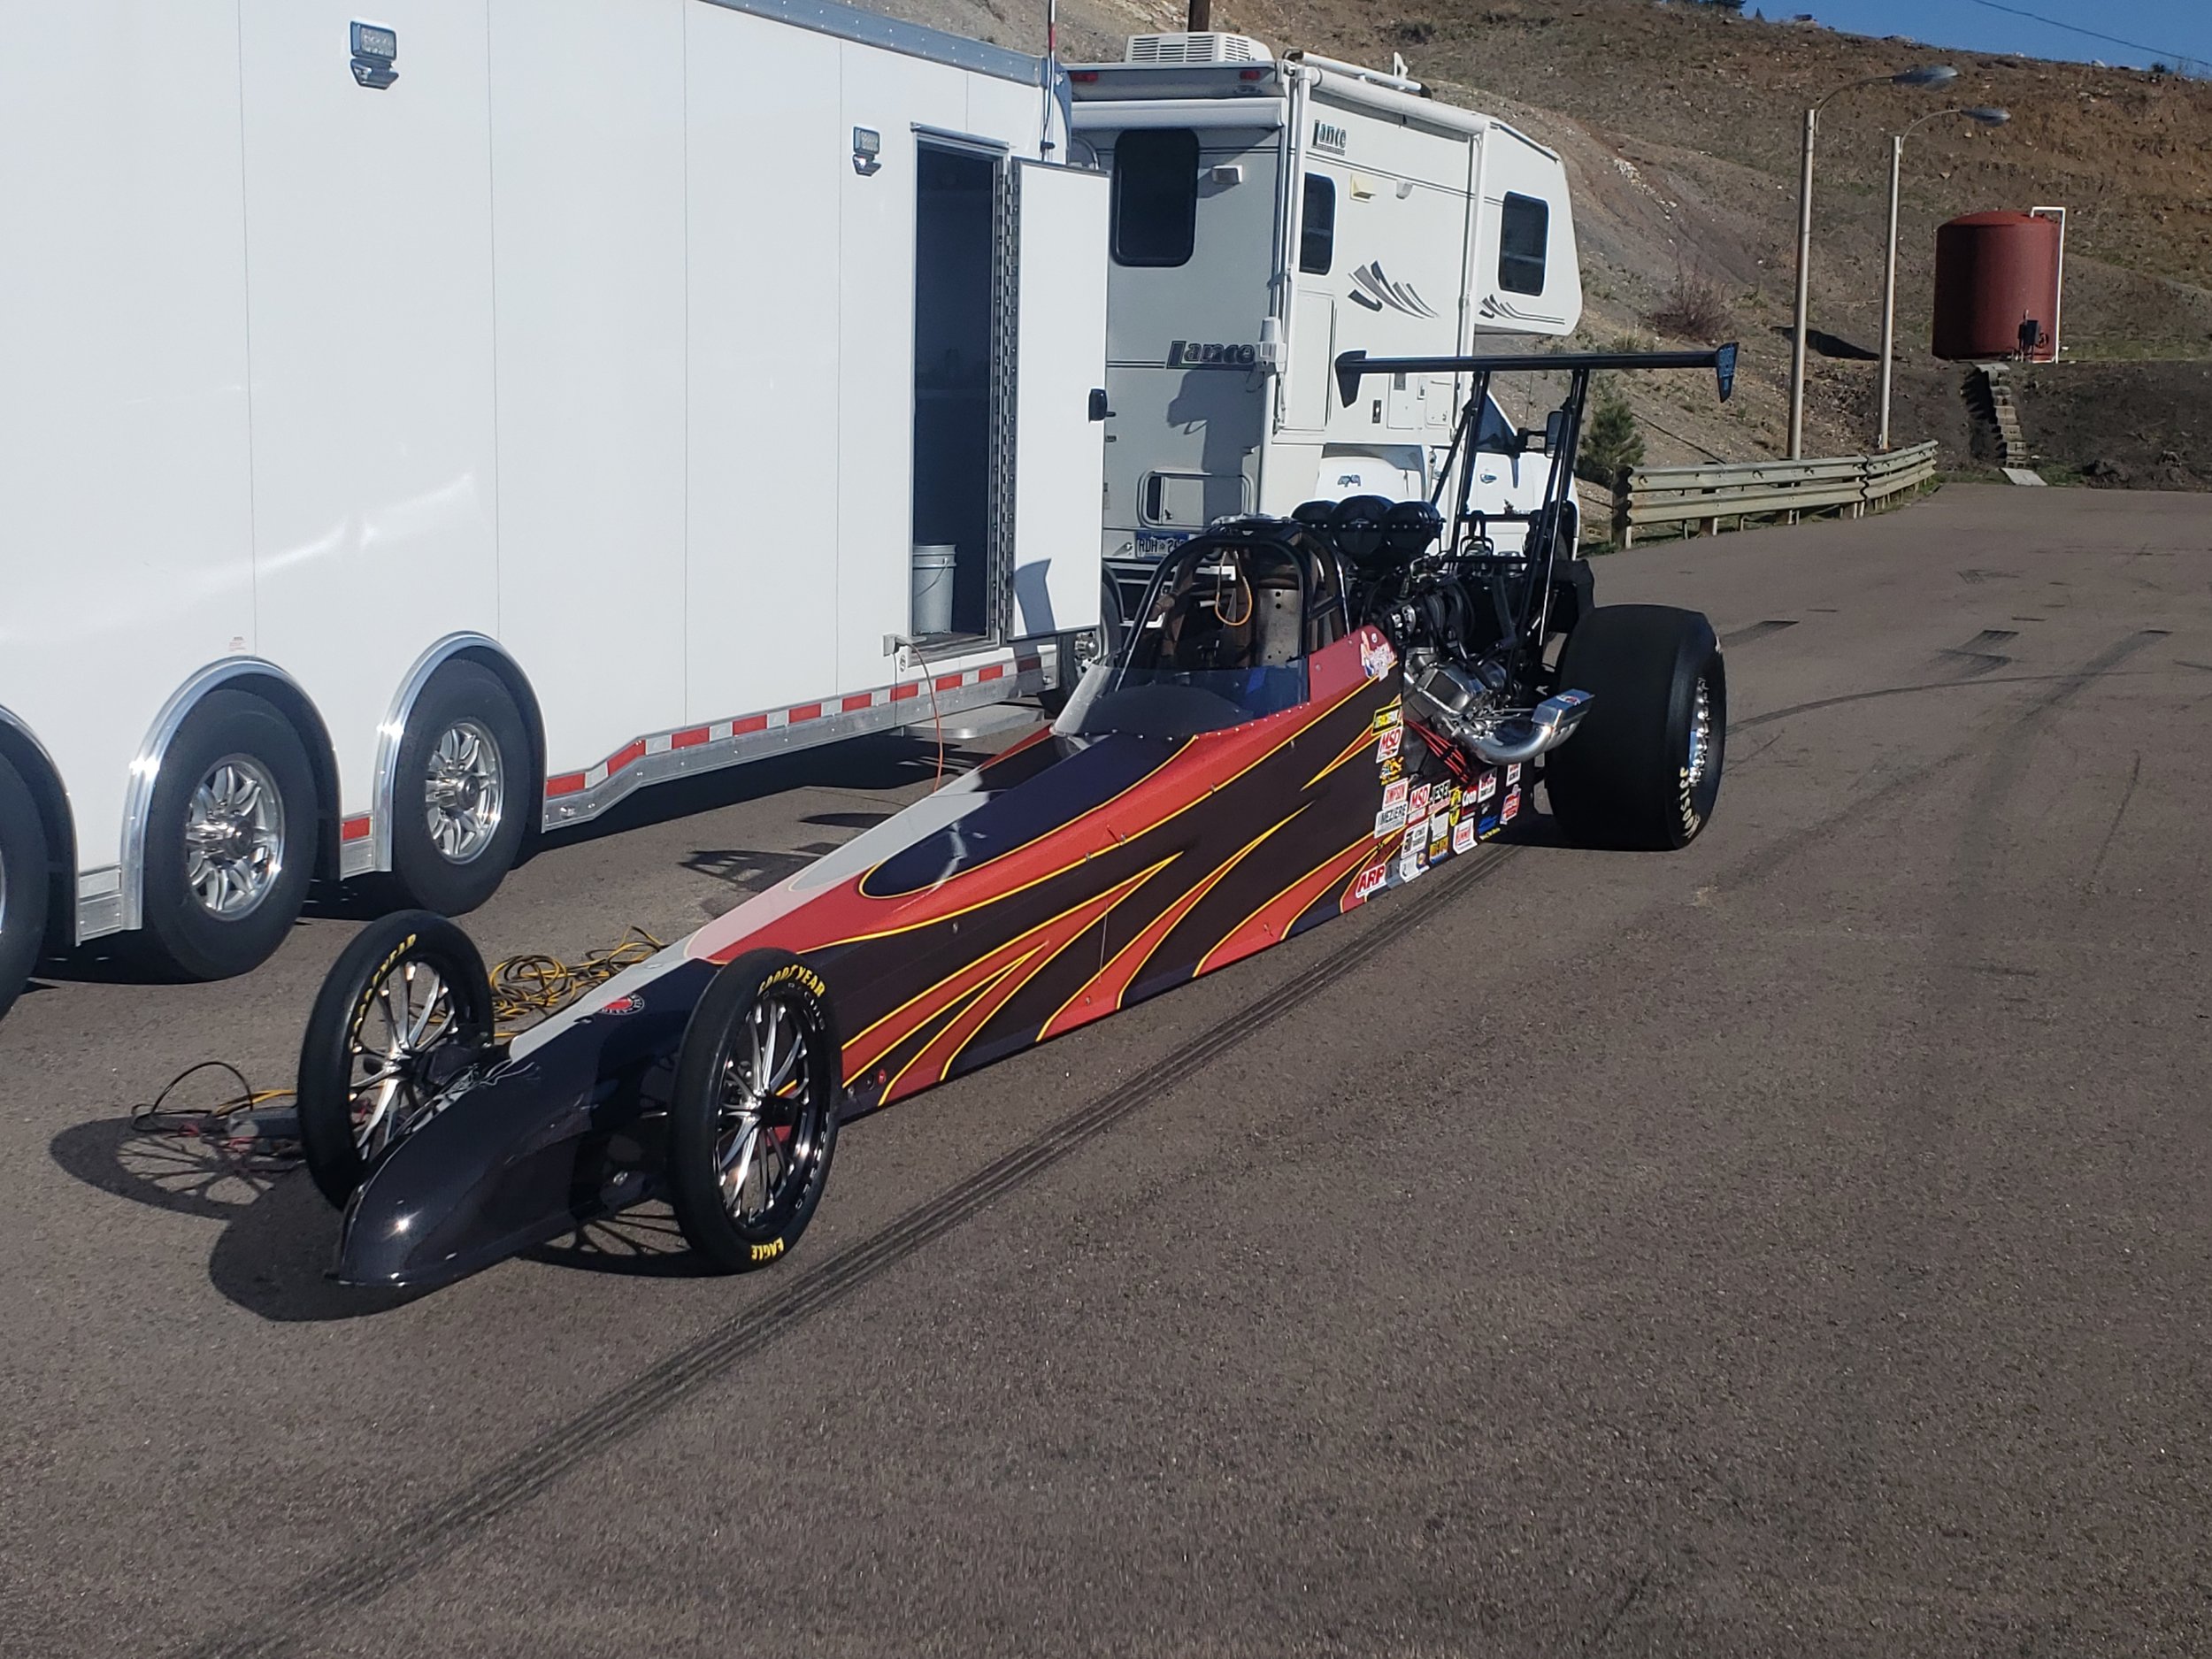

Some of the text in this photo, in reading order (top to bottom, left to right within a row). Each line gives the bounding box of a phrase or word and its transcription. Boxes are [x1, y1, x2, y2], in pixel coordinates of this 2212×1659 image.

[1312, 119, 1346, 149] Lance
[1166, 341, 1256, 371] Lance
[1381, 728, 1401, 749] MSD
[1411, 787, 1429, 809] MSD
[1357, 865, 1385, 893] ARP
[751, 1237, 784, 1261] EAGLE
